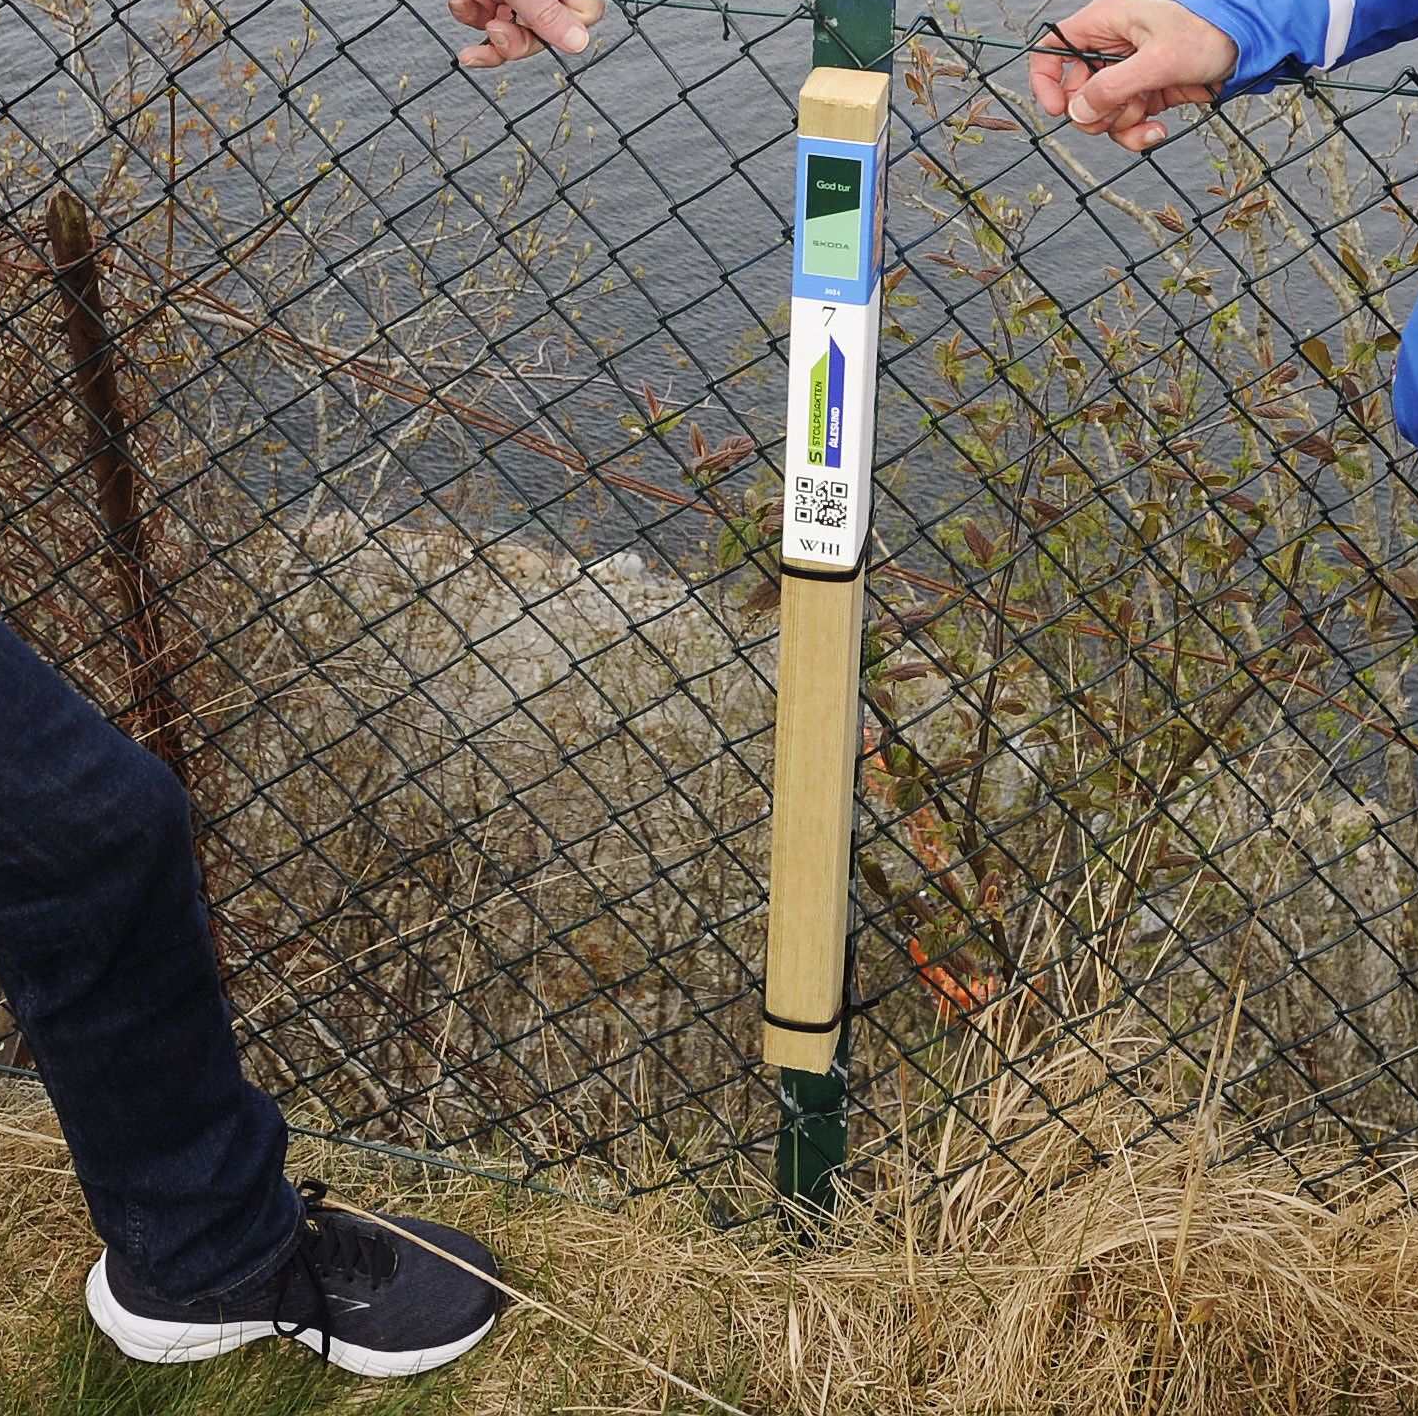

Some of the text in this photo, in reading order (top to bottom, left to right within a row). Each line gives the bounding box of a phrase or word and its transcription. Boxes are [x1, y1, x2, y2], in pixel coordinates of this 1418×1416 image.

[816, 179, 852, 193] God tur
[822, 306, 837, 327] 7
